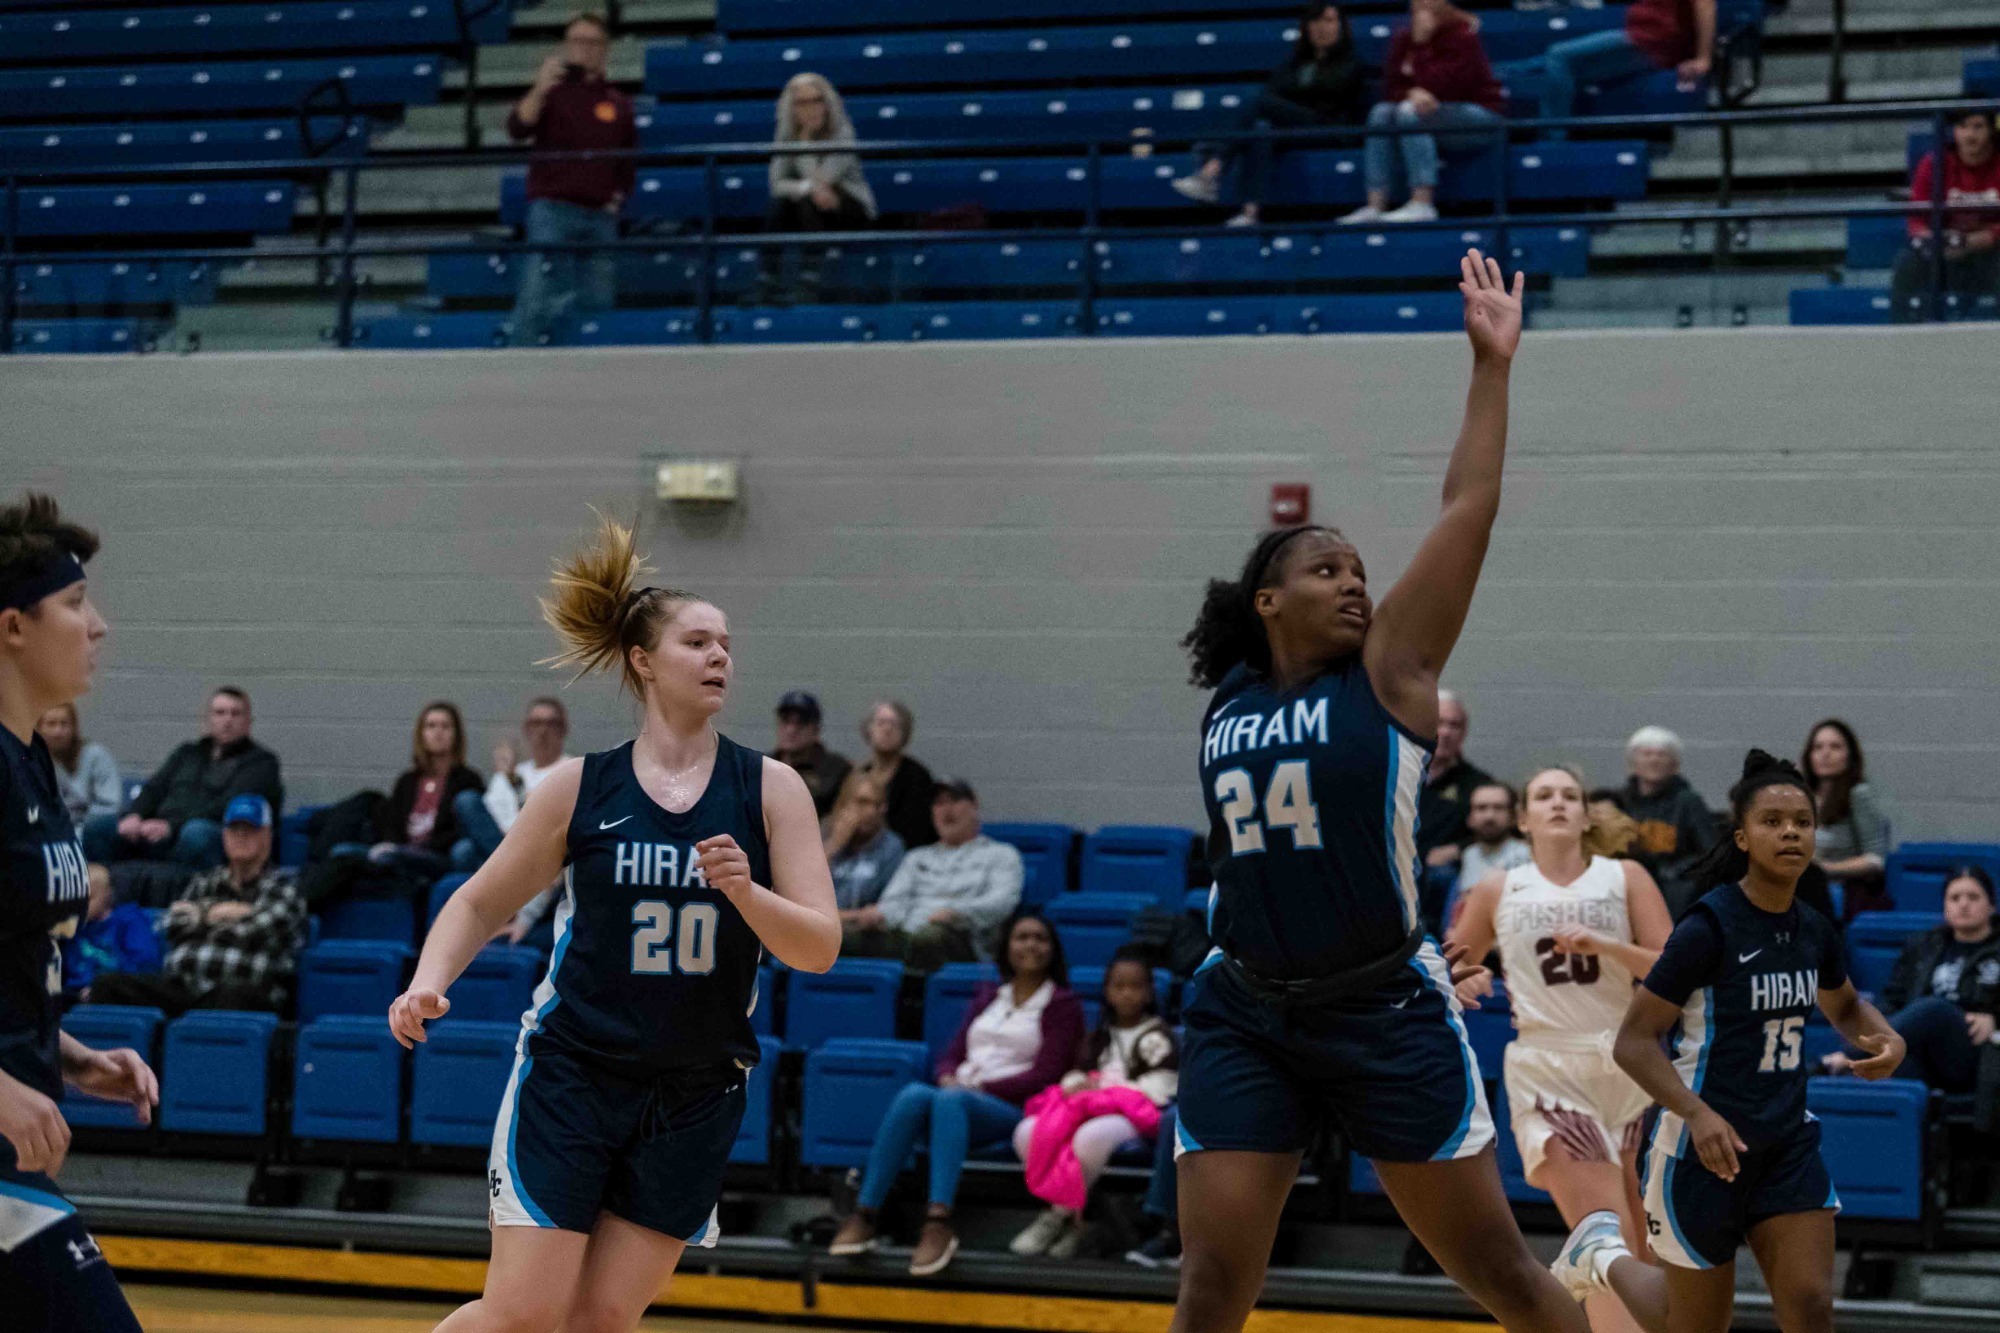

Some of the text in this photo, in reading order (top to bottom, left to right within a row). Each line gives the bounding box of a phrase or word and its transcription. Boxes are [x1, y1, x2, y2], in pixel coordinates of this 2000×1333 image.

[1204, 697, 1330, 768] HIRAM
[1214, 758, 1325, 858] 24
[43, 840, 91, 904] HIRA
[614, 841, 708, 888] HIRA
[630, 899, 720, 976] 20
[1512, 898, 1619, 934] FISHER
[1535, 937, 1600, 986] 20
[1756, 1015, 1806, 1073] 15
